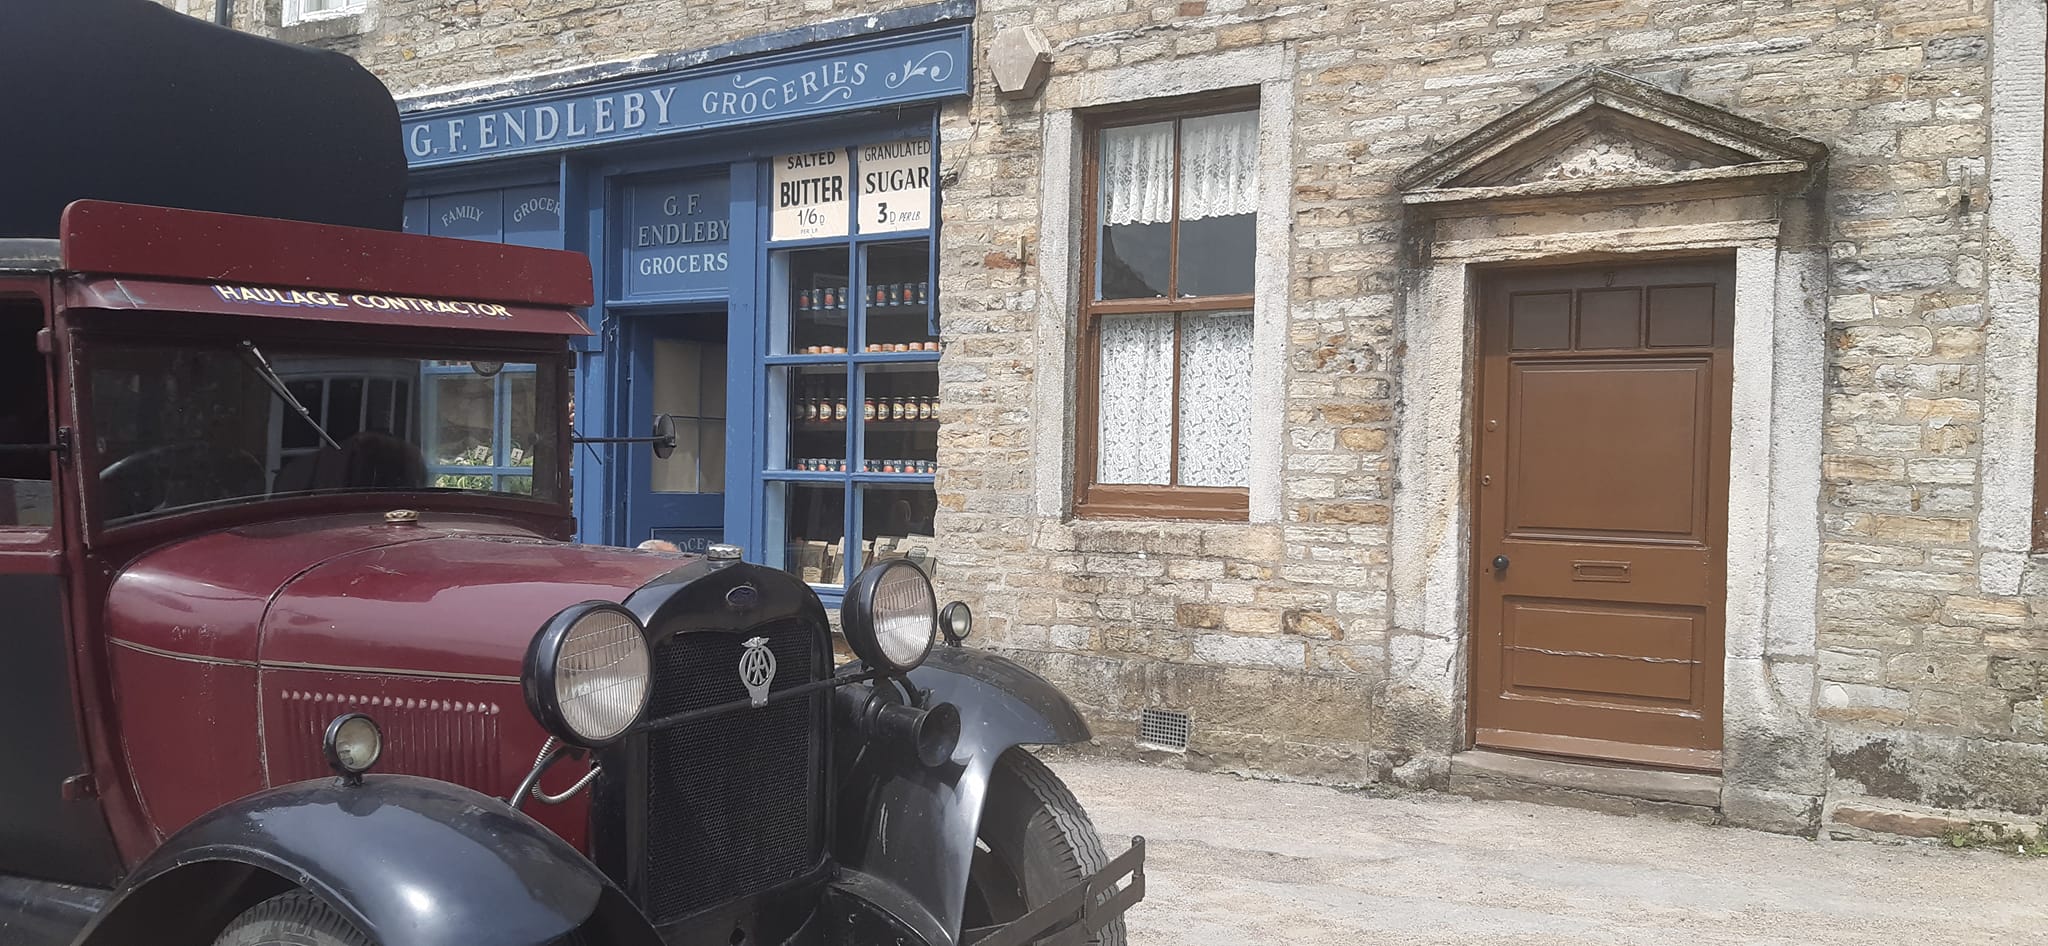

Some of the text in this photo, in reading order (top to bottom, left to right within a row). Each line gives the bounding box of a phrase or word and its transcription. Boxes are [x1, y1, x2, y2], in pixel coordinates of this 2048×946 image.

[702, 61, 868, 115] GROCERIES
[410, 87, 677, 157] G. F. ENDLEBY
[787, 151, 836, 170] SALTED
[864, 139, 930, 162] GRANULATED
[780, 175, 843, 208] BUTTER
[865, 166, 929, 194] SUGAR
[441, 205, 484, 227] FAMILY
[663, 194, 703, 216] G. F.
[877, 202, 888, 224] 3
[797, 208, 817, 227] 1/6
[638, 219, 730, 247] ENDLEBY
[640, 252, 728, 275] GROCERS
[213, 285, 513, 319] HAULAGE CONTRACTOR
